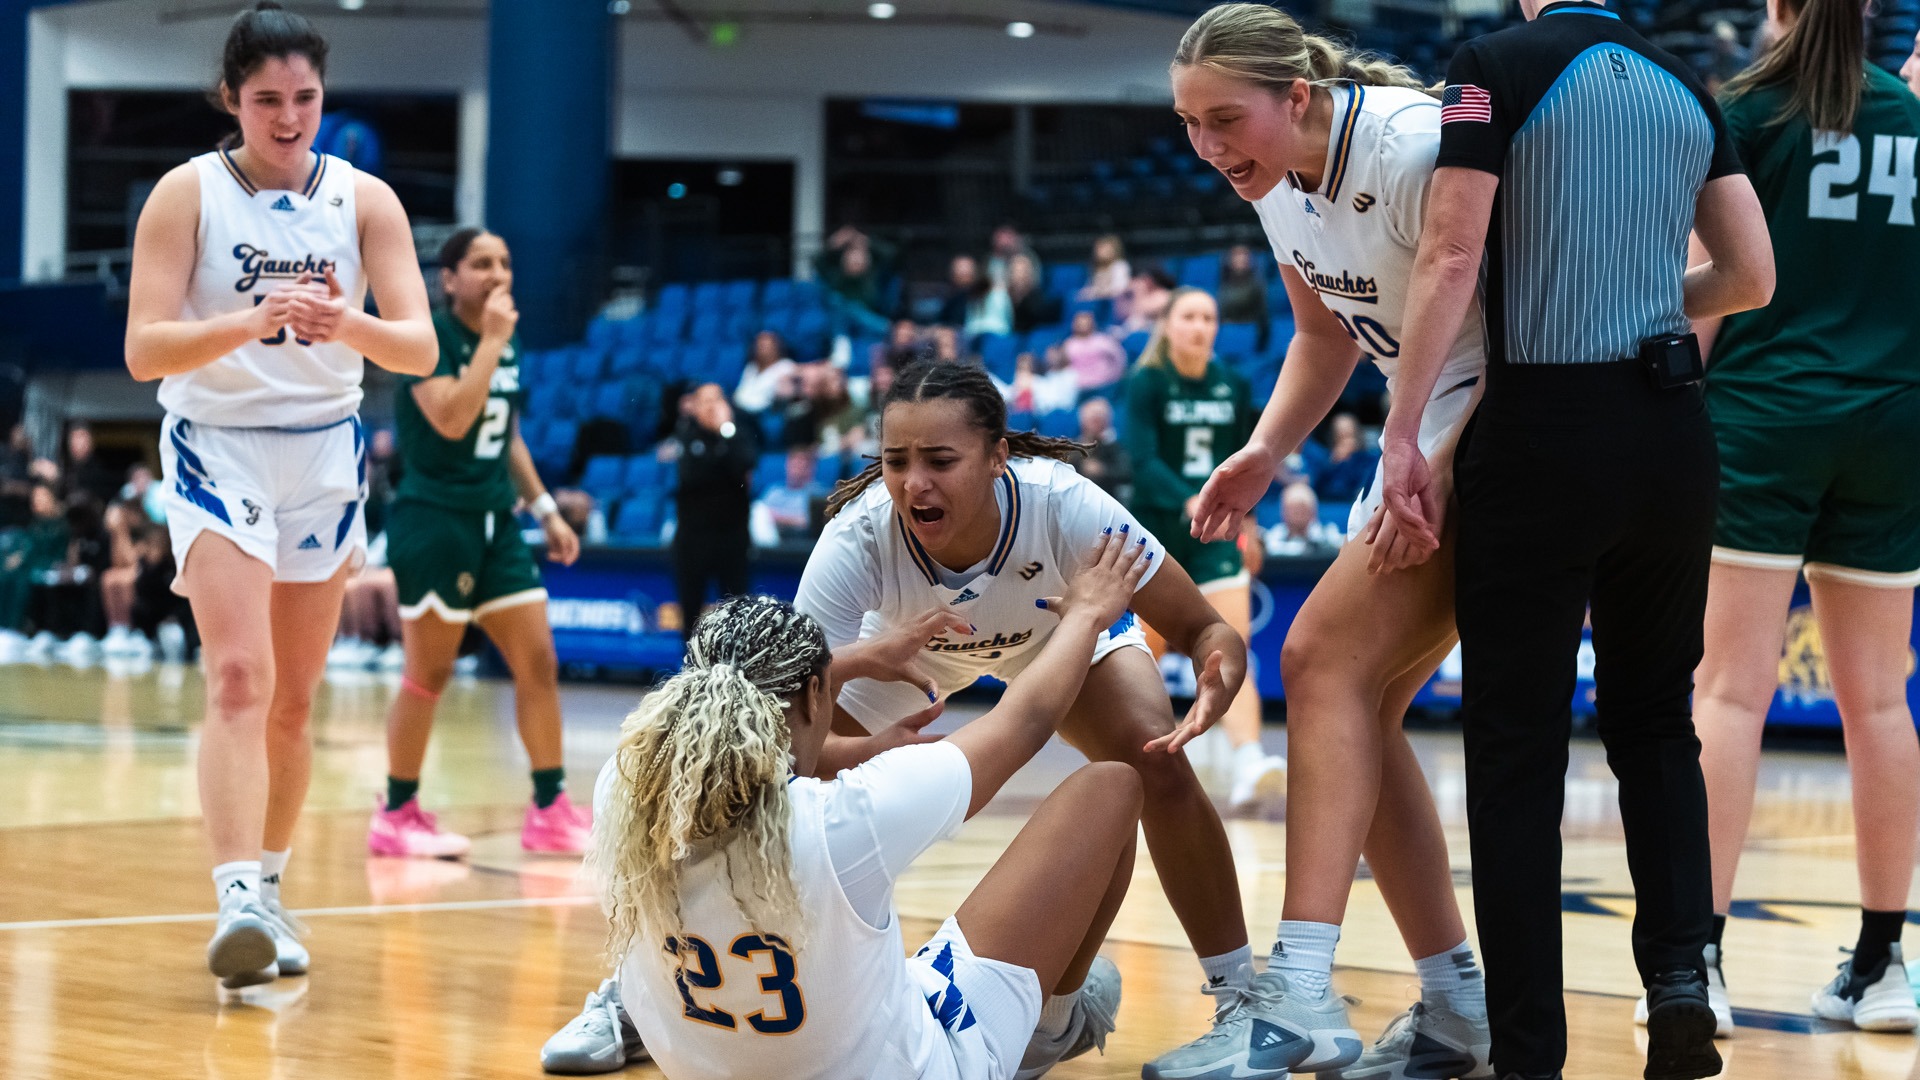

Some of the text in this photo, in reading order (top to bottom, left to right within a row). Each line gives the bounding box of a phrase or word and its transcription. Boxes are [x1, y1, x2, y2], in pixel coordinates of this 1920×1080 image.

[1808, 128, 1919, 226] 24
[1292, 249, 1378, 302] Gauchos
[474, 397, 510, 459] 2
[1182, 427, 1214, 477] 5
[924, 628, 1032, 653] Gauchos
[660, 932, 807, 1037] 23
